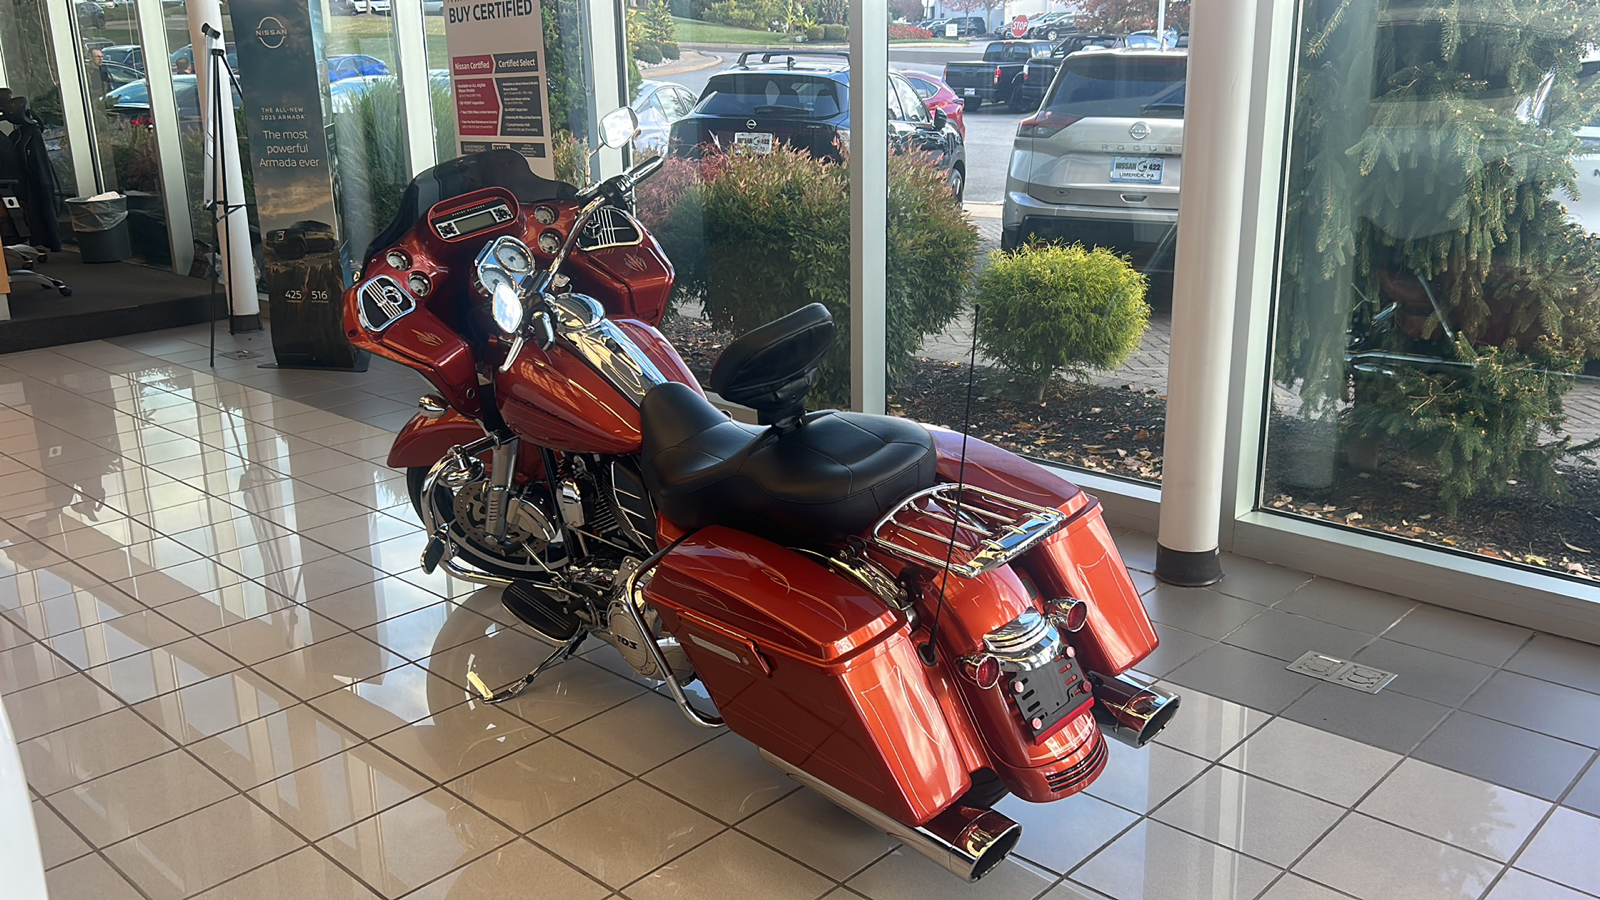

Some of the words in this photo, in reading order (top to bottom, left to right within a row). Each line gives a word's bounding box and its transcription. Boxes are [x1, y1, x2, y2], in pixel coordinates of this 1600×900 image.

[449, 6, 470, 23] BUY
[473, 0, 532, 20] CERTIFIED
[1012, 21, 1028, 30] STOP
[454, 62, 469, 70] Nissan
[470, 60, 490, 69] Certified
[498, 58, 519, 68] Certified
[520, 58, 535, 66] Select
[262, 130, 281, 140] The
[282, 130, 309, 139] most
[266, 143, 309, 156] powerful
[1101, 144, 1173, 152] ROGUE
[259, 158, 297, 167] Armada
[298, 159, 320, 167] ever
[1115, 162, 1137, 170] NISSAN
[285, 290, 302, 299] 425
[311, 290, 328, 299] 516
[617, 634, 638, 650] 103
